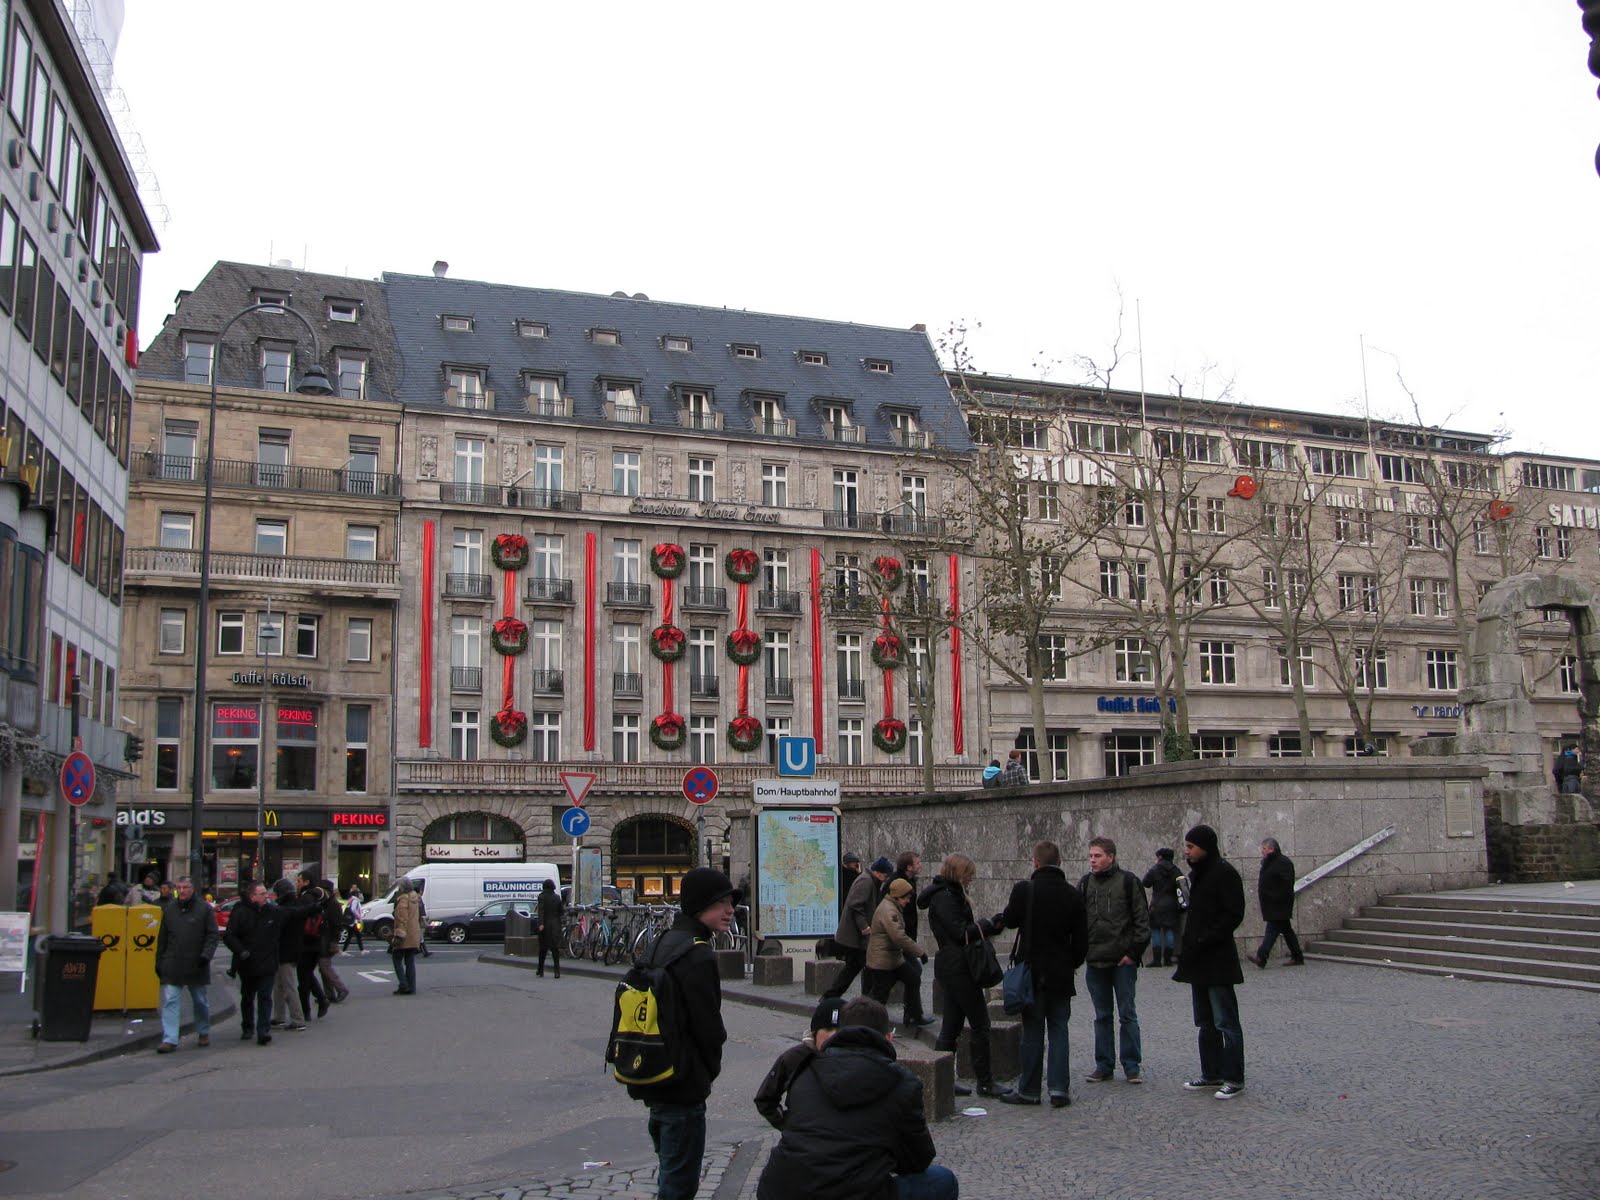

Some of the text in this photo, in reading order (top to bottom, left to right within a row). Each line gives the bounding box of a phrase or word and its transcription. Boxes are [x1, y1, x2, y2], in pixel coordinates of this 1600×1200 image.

[1012, 451, 1117, 487] SATURN
[629, 496, 783, 524] Excelsior Hotel Ernst
[1548, 503, 1600, 530] SATU
[272, 672, 309, 687] Kölsch
[216, 708, 257, 720] PEKING
[277, 709, 313, 721] PEKING
[786, 742, 808, 771] U
[757, 787, 837, 798] Dom/Hauptbahnhof
[333, 813, 386, 825] PEKING
[429, 846, 500, 856] taku taku
[485, 882, 544, 891] BRÄUNINGER
